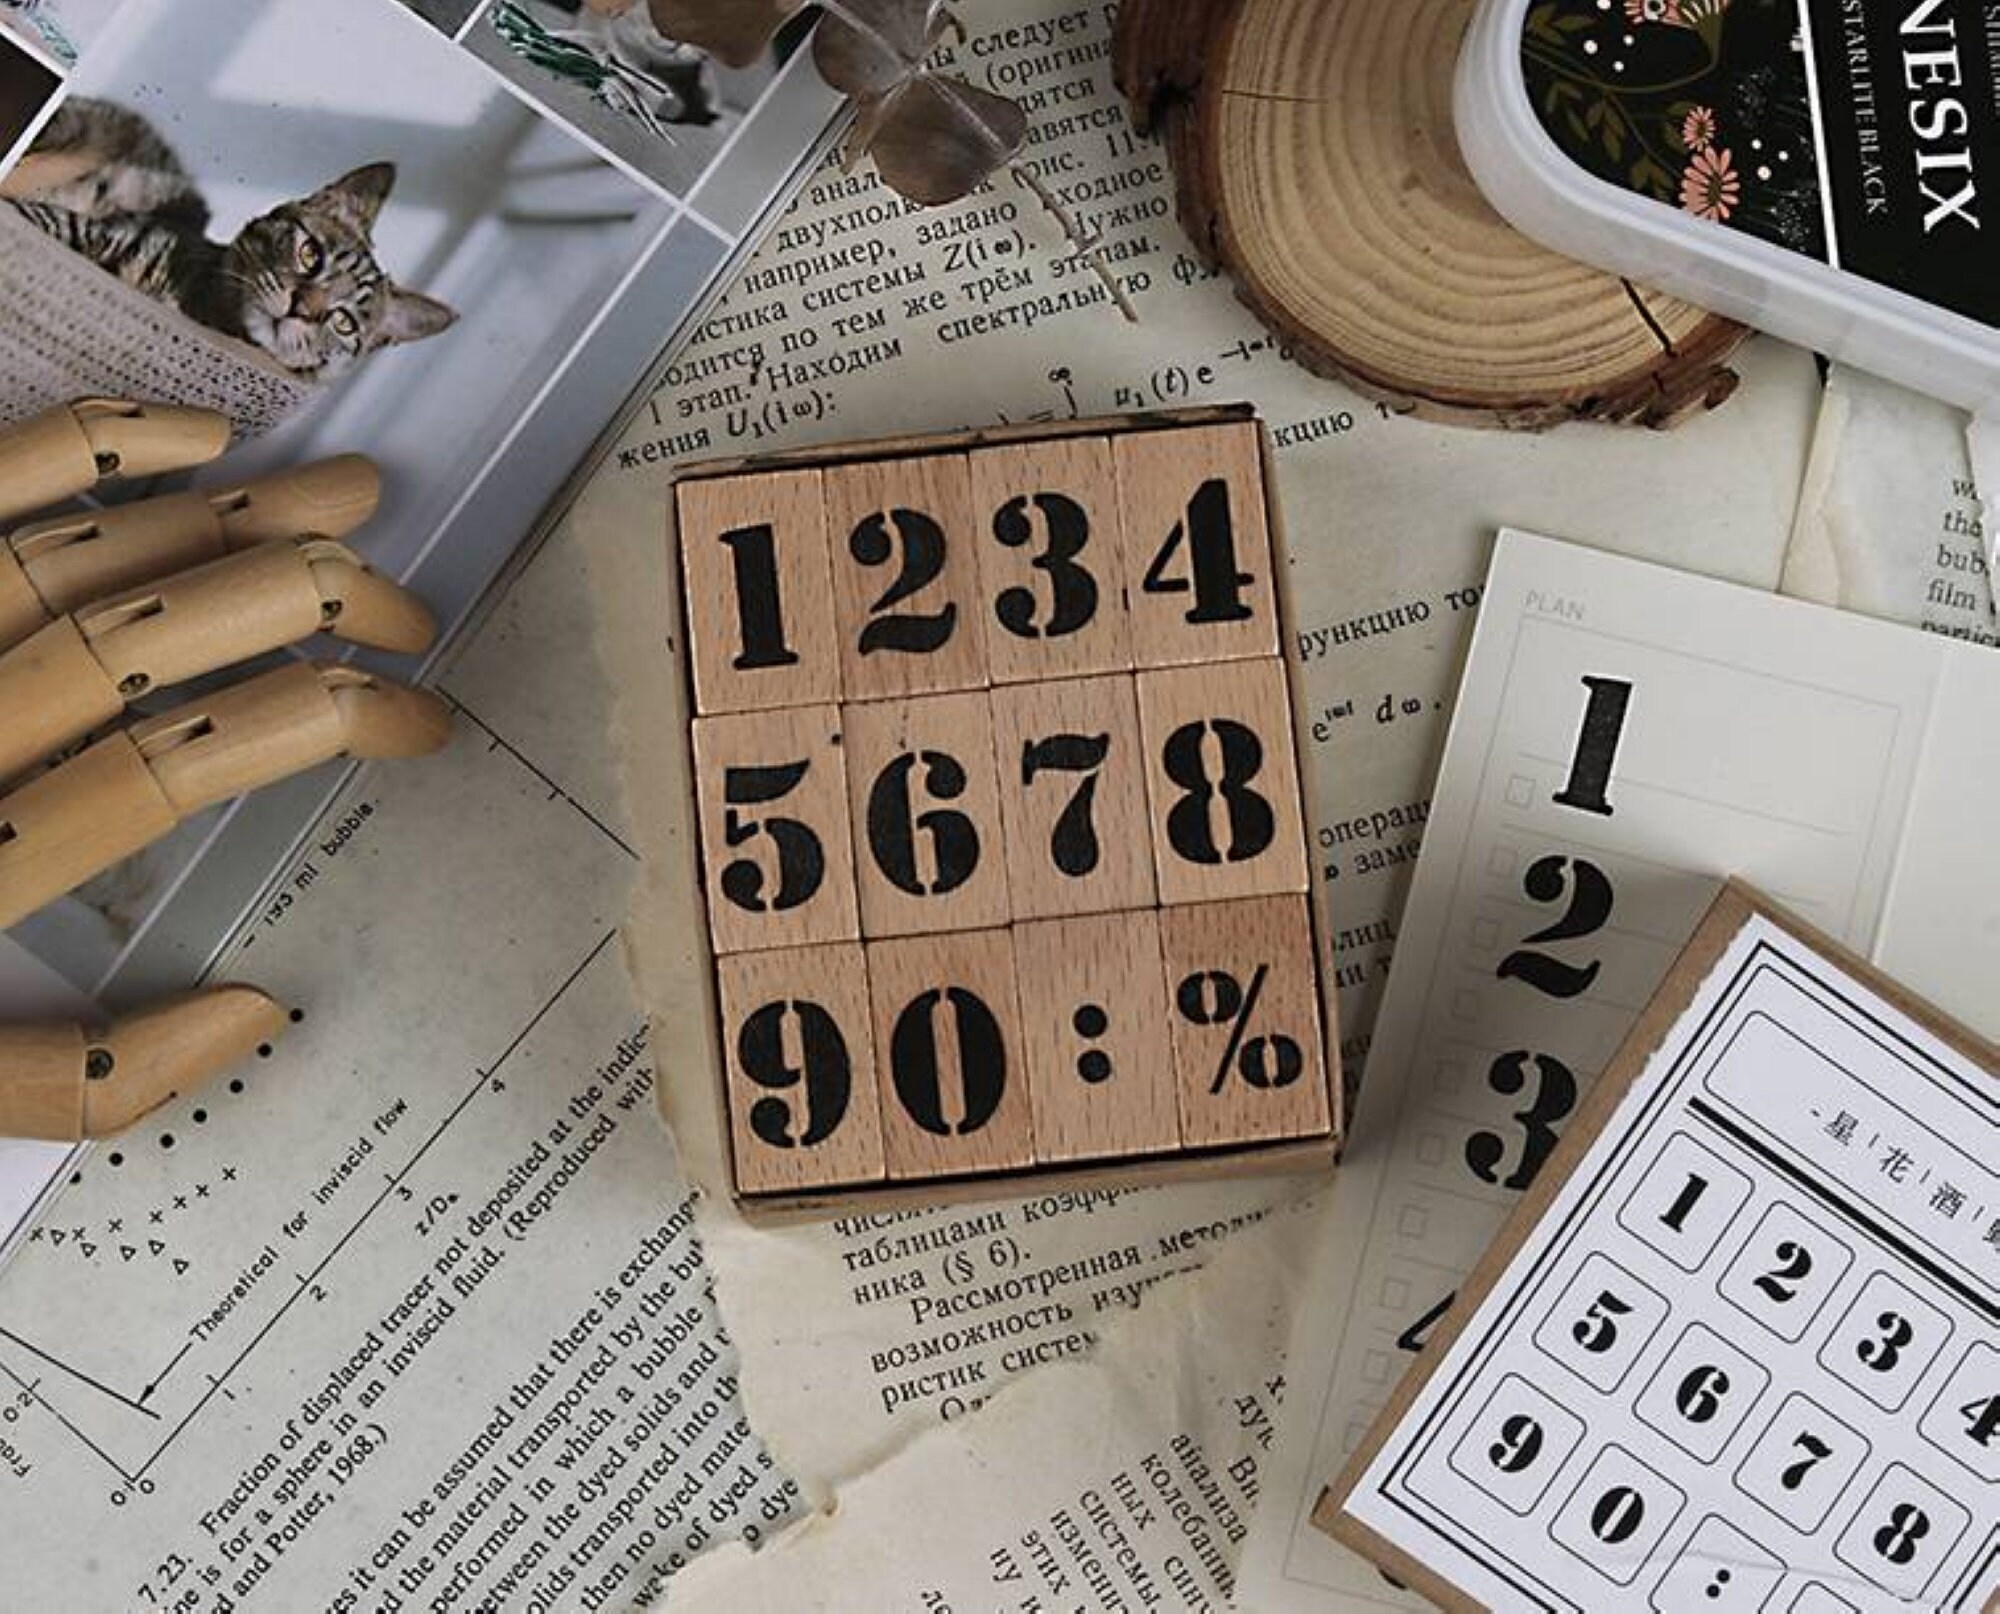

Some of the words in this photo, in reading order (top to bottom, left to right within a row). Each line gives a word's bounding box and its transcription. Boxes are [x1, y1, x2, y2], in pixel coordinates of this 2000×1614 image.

[971, 9, 1090, 57] следует
[1056, 162, 1163, 206] ходное
[1857, 129, 1888, 213] BLACK
[744, 236, 897, 294] например,
[916, 202, 1018, 246] задано
[781, 327, 818, 352] по
[833, 308, 887, 338] тем
[902, 290, 947, 318] же
[961, 267, 1034, 304] трём
[802, 261, 926, 312] системы
[677, 382, 752, 418] этап.
[766, 338, 902, 392] Находим
[937, 271, 1152, 343] спектральню
[618, 427, 711, 469] жения
[718, 524, 798, 670] 1
[849, 507, 957, 656] 2
[992, 492, 1099, 639] 3
[1142, 477, 1255, 625] 4
[1525, 591, 1586, 620] PLAN
[1926, 578, 1976, 611] film
[1552, 675, 1633, 816] 1
[721, 757, 825, 912] 5
[866, 750, 980, 896] 6
[1021, 732, 1110, 878] 7
[1163, 718, 1276, 865] 8
[1497, 854, 1614, 998] 2
[738, 999, 851, 1149] 9
[890, 986, 1007, 1136] 0
[1074, 1004, 1111, 1084] :
[1177, 964, 1303, 1095] %
[1465, 1050, 1577, 1190] 3
[190, 1245, 279, 1342] Theoretical
[283, 1210, 311, 1243] for
[311, 1137, 374, 1205] inviscid
[374, 1099, 409, 1135] flow
[842, 1210, 1007, 1272] таблицами
[910, 1243, 1142, 1326] Рассмотренная
[138, 1553, 194, 1603] 7.23.
[199, 1452, 281, 1537] Fraction
[279, 1420, 305, 1451] of
[303, 1332, 384, 1427] displaced
[381, 1273, 436, 1335] tracer
[435, 1236, 470, 1276] not
[466, 1140, 552, 1238] deposited
[549, 1118, 574, 1147] at
[568, 1083, 604, 1122] the
[597, 1022, 650, 1086] indic
[196, 1565, 222, 1586] is
[219, 1527, 253, 1563] for
[255, 1508, 273, 1526] a
[272, 1438, 333, 1505] sphere
[329, 1411, 357, 1438] in
[358, 1379, 387, 1409] an
[383, 1299, 456, 1381] inviscid
[453, 1246, 506, 1300] fluid.
[503, 1113, 617, 1241] (Reproduced
[310, 1284, 327, 1301] 2
[853, 1268, 926, 1306] ника
[871, 1300, 1073, 1374] возможность
[1659, 1173, 1708, 1233] 1
[1753, 1241, 1812, 1302] 2
[1856, 1311, 1913, 1372] 3
[1959, 1395, 2000, 1446] 4
[349, 1566, 376, 1590] it
[372, 1529, 412, 1569] can
[402, 1499, 437, 1528] be
[432, 1406, 515, 1500] assumed
[510, 1361, 556, 1411] that
[549, 1305, 604, 1366] there
[595, 1286, 622, 1310] is
[399, 1556, 435, 1594] the
[433, 1464, 514, 1558] material
[506, 1344, 618, 1470] transported
[615, 1315, 645, 1350] by
[639, 1281, 677, 1320] the
[881, 1357, 986, 1413] ристик
[1572, 1290, 1633, 1353] 5
[1676, 1365, 1730, 1423] 6
[1780, 1430, 1833, 1490] 7
[1873, 1503, 1930, 1564] 8
[233, 1551, 272, 1597] and
[264, 1490, 336, 1556] Potter,
[328, 1423, 388, 1487] 1968.)
[430, 1501, 530, 1614] performed
[523, 1476, 556, 1505] in
[555, 1406, 617, 1472] which
[616, 1383, 635, 1405] a
[632, 1305, 703, 1381] bubble
[466, 1540, 550, 1614] etween
[544, 1502, 581, 1541] the
[577, 1446, 628, 1504] dyed
[624, 1388, 683, 1452] solids
[678, 1341, 719, 1391] and
[570, 1443, 680, 1568] transported
[676, 1398, 720, 1448] into
[686, 1518, 712, 1552] of
[709, 1466, 760, 1526] dyed
[1110, 1472, 1156, 1531] ных
[1169, 1434, 1248, 1545] анализа
[1488, 1414, 1543, 1473] 9
[1591, 1485, 1645, 1544] 0
[581, 1561, 630, 1612] then
[626, 1530, 657, 1564] no
[654, 1472, 703, 1533] dyed
[1020, 1530, 1070, 1594] этих
